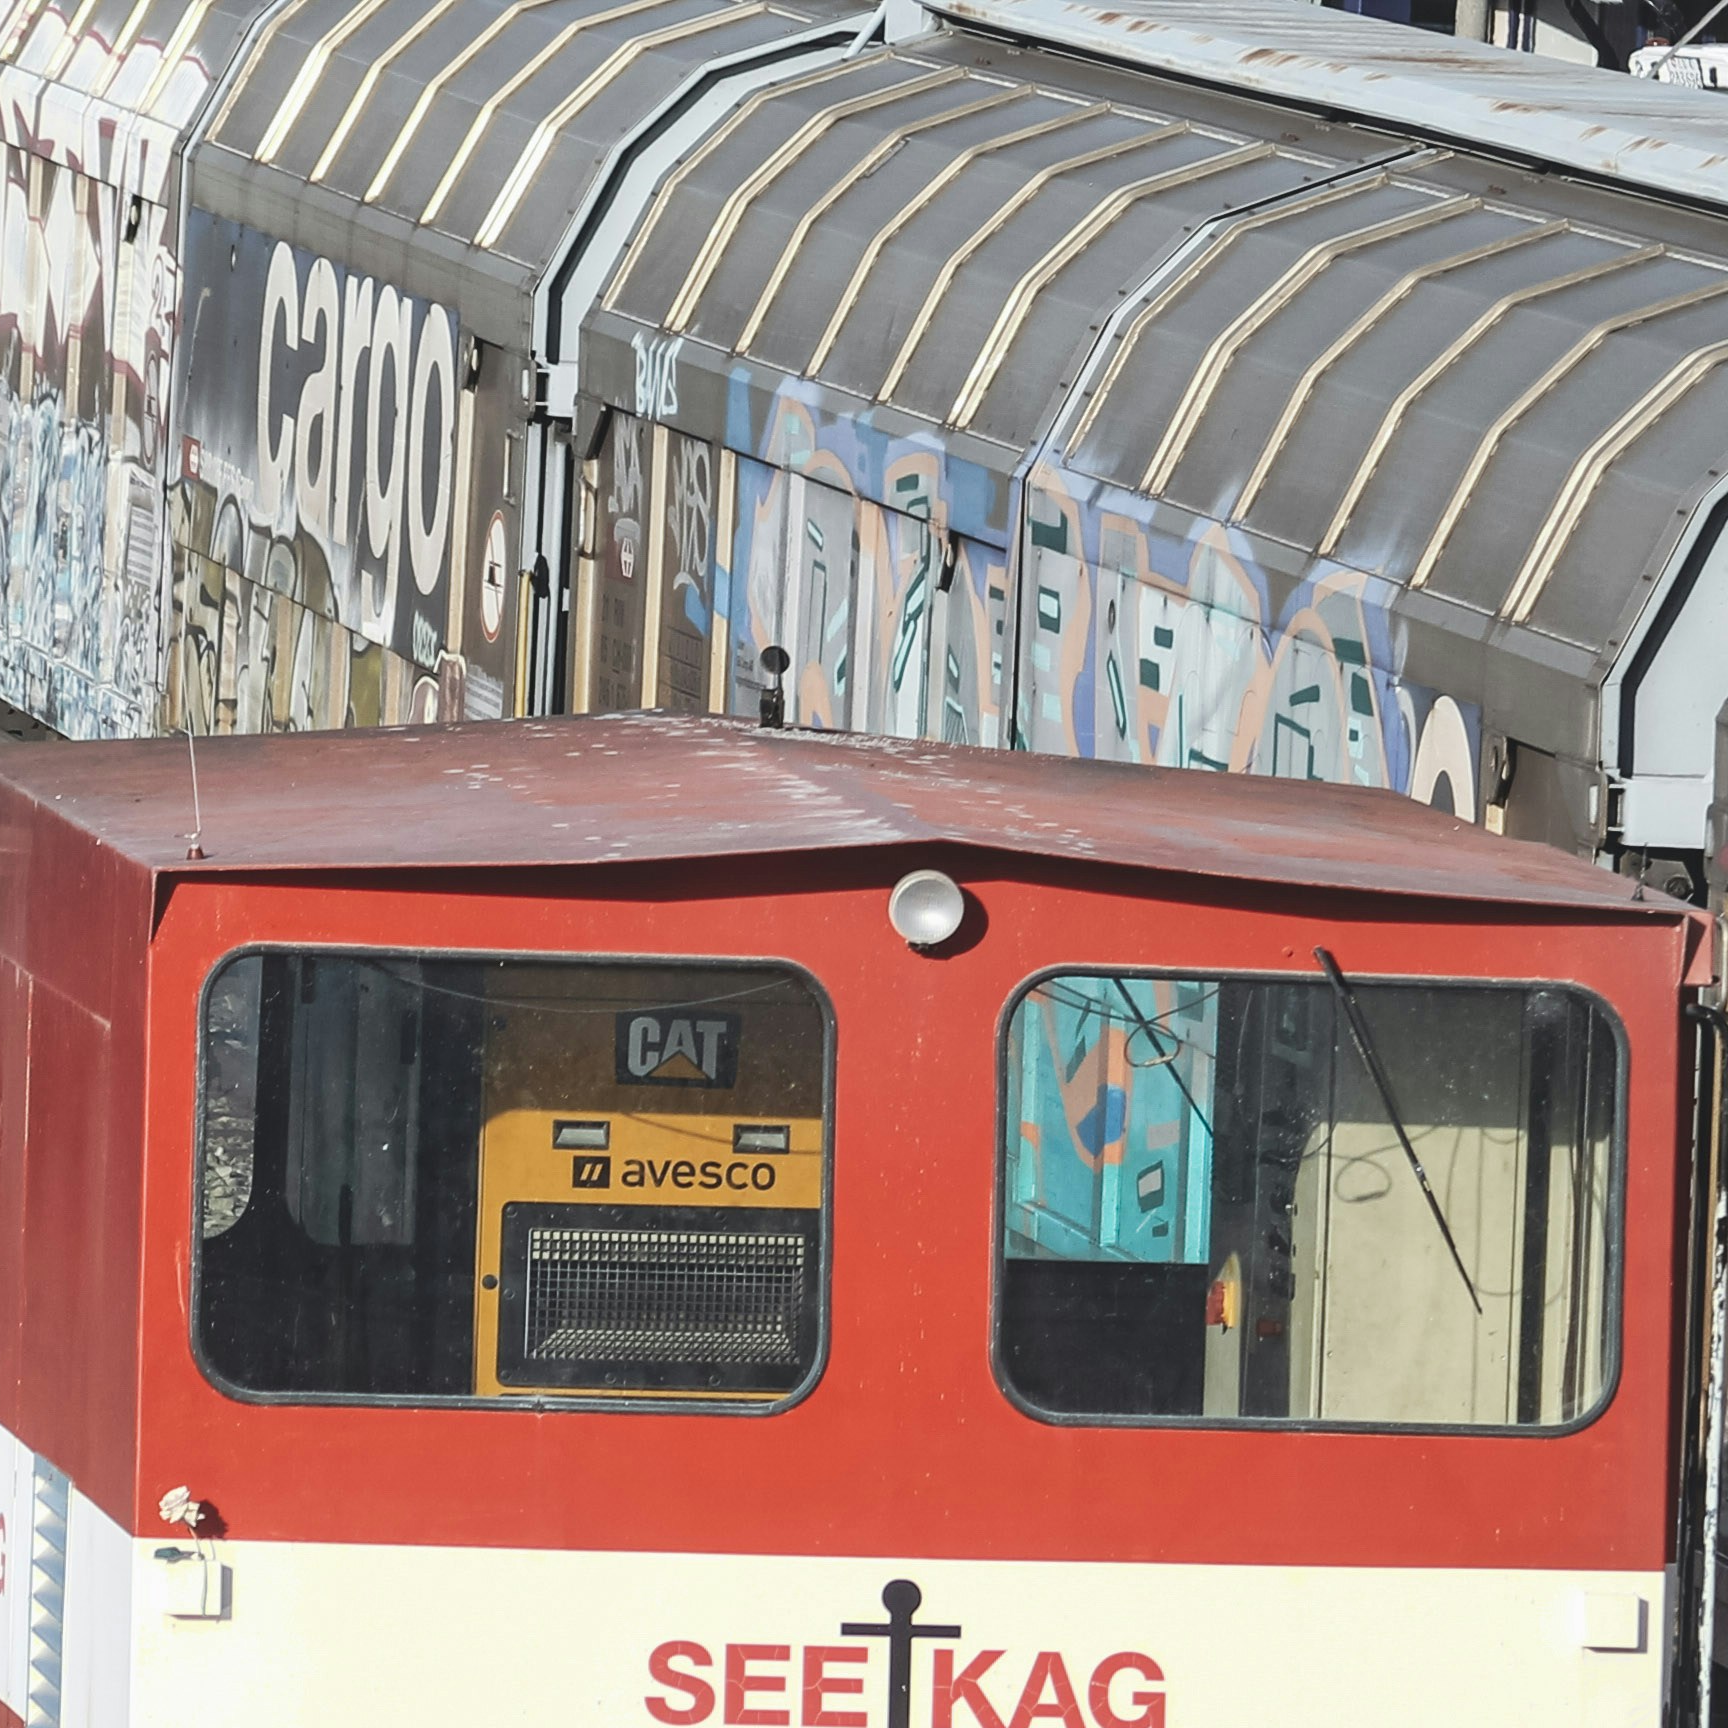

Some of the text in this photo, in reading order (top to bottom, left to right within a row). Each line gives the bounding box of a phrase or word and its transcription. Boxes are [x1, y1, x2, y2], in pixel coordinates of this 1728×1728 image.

[256, 240, 455, 648] cargo
[627, 1015, 728, 1080] CAT
[621, 1156, 776, 1191] avesco
[643, 1640, 870, 1728] SEE
